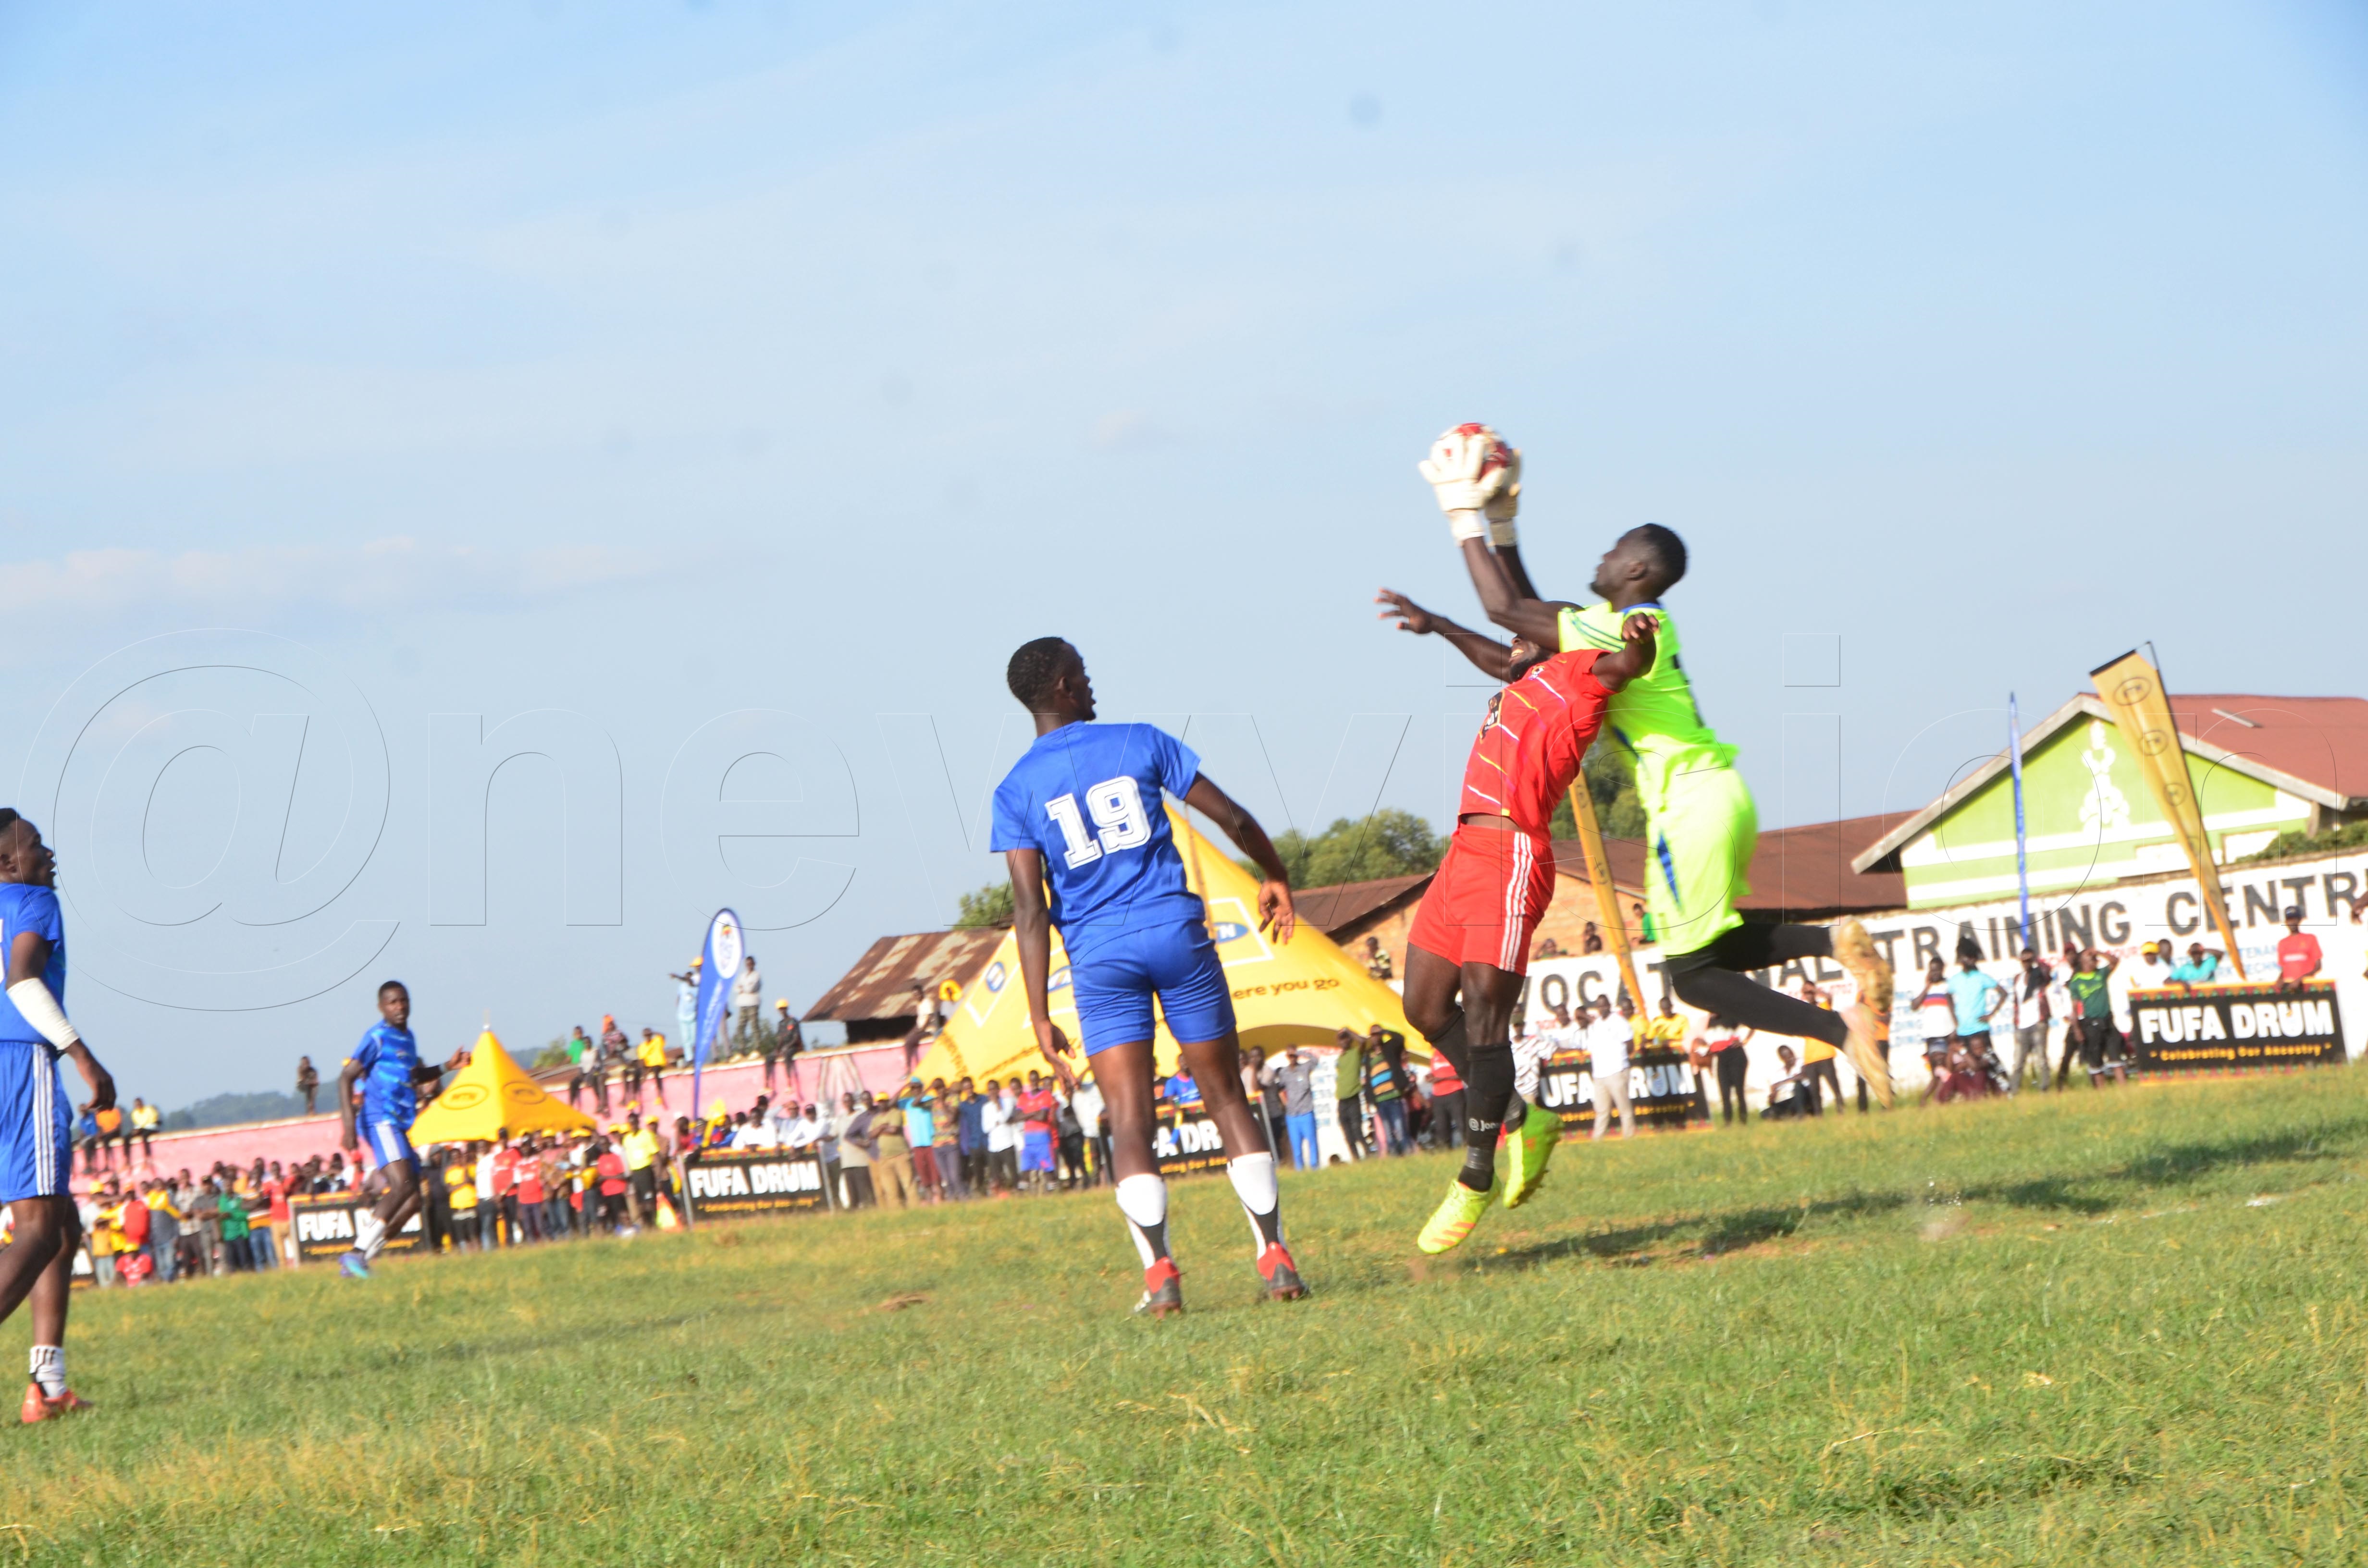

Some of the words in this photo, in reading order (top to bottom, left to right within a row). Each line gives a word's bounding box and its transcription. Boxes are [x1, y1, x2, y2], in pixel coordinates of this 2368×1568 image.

[1044, 775, 1152, 870] 19
[2166, 868, 2368, 936] CENTR
[1233, 986, 1267, 999] ere
[1270, 980, 1308, 996] you
[1313, 979, 1340, 991] go
[2138, 1005, 2227, 1044] FUFA
[2230, 1000, 2335, 1039] DRUM
[1539, 1070, 1595, 1108] UFA
[1628, 1061, 1697, 1100] RUM
[1179, 1119, 1223, 1154] DR
[688, 1165, 750, 1198] FUFA
[749, 1160, 822, 1195] DRUM
[297, 1209, 355, 1243] FUFA
